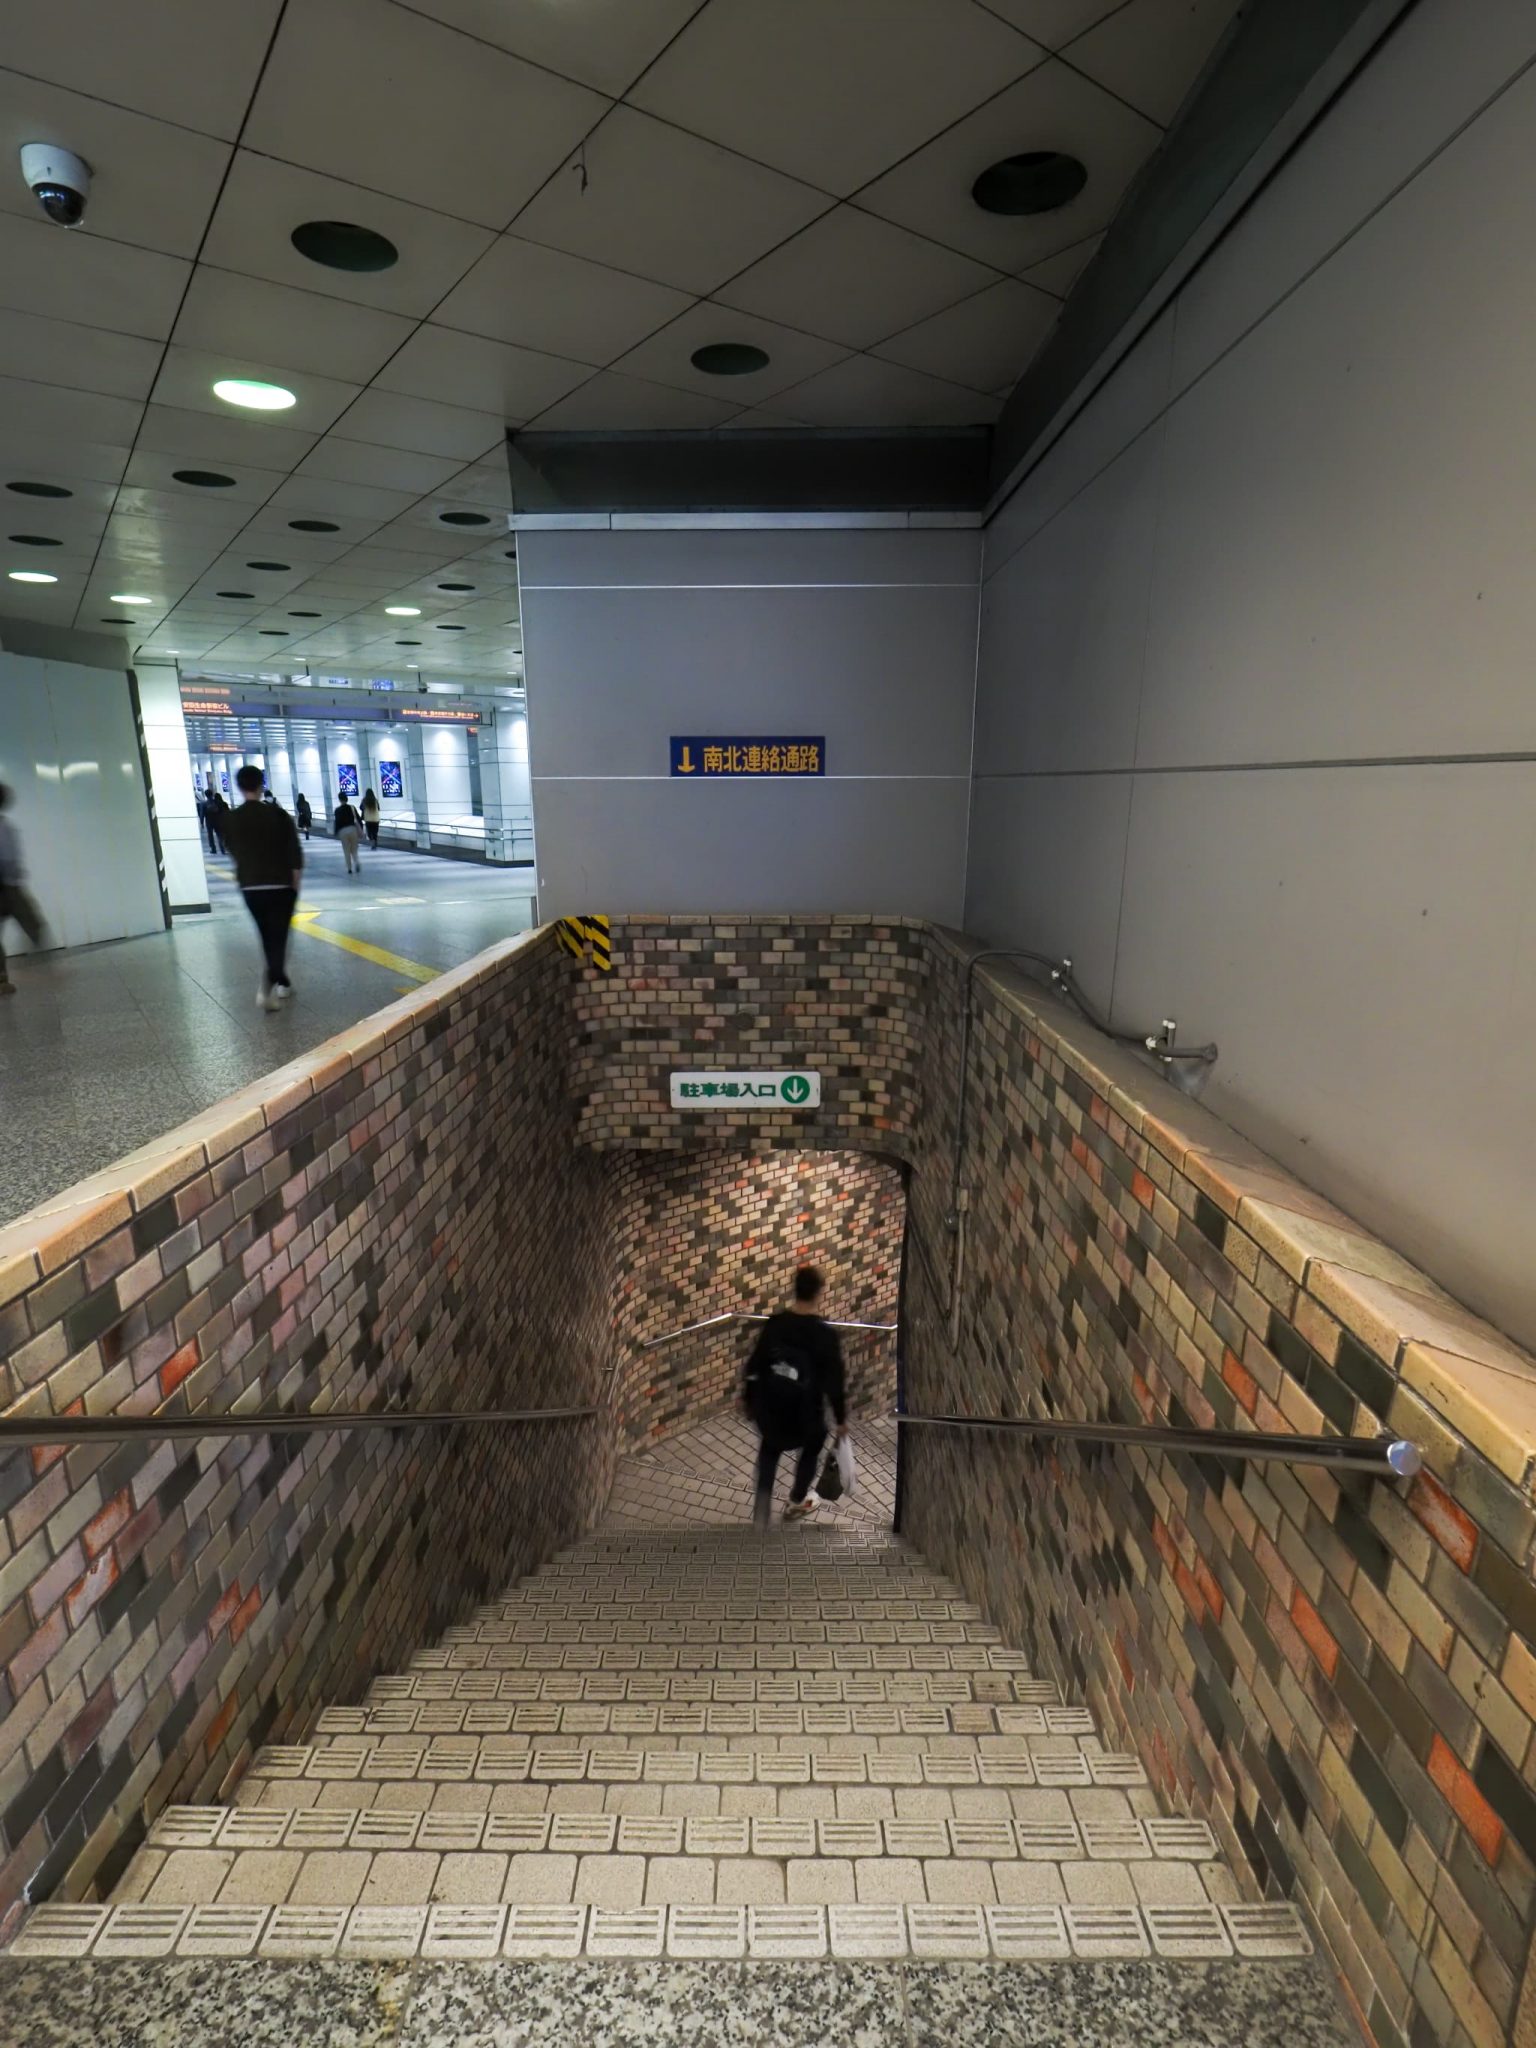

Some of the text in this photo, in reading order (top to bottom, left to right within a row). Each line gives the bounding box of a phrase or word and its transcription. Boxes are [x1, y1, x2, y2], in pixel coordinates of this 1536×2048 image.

[703, 745, 819, 773] 南北連絡通路
[680, 1082, 776, 1098] 駐車場入口
